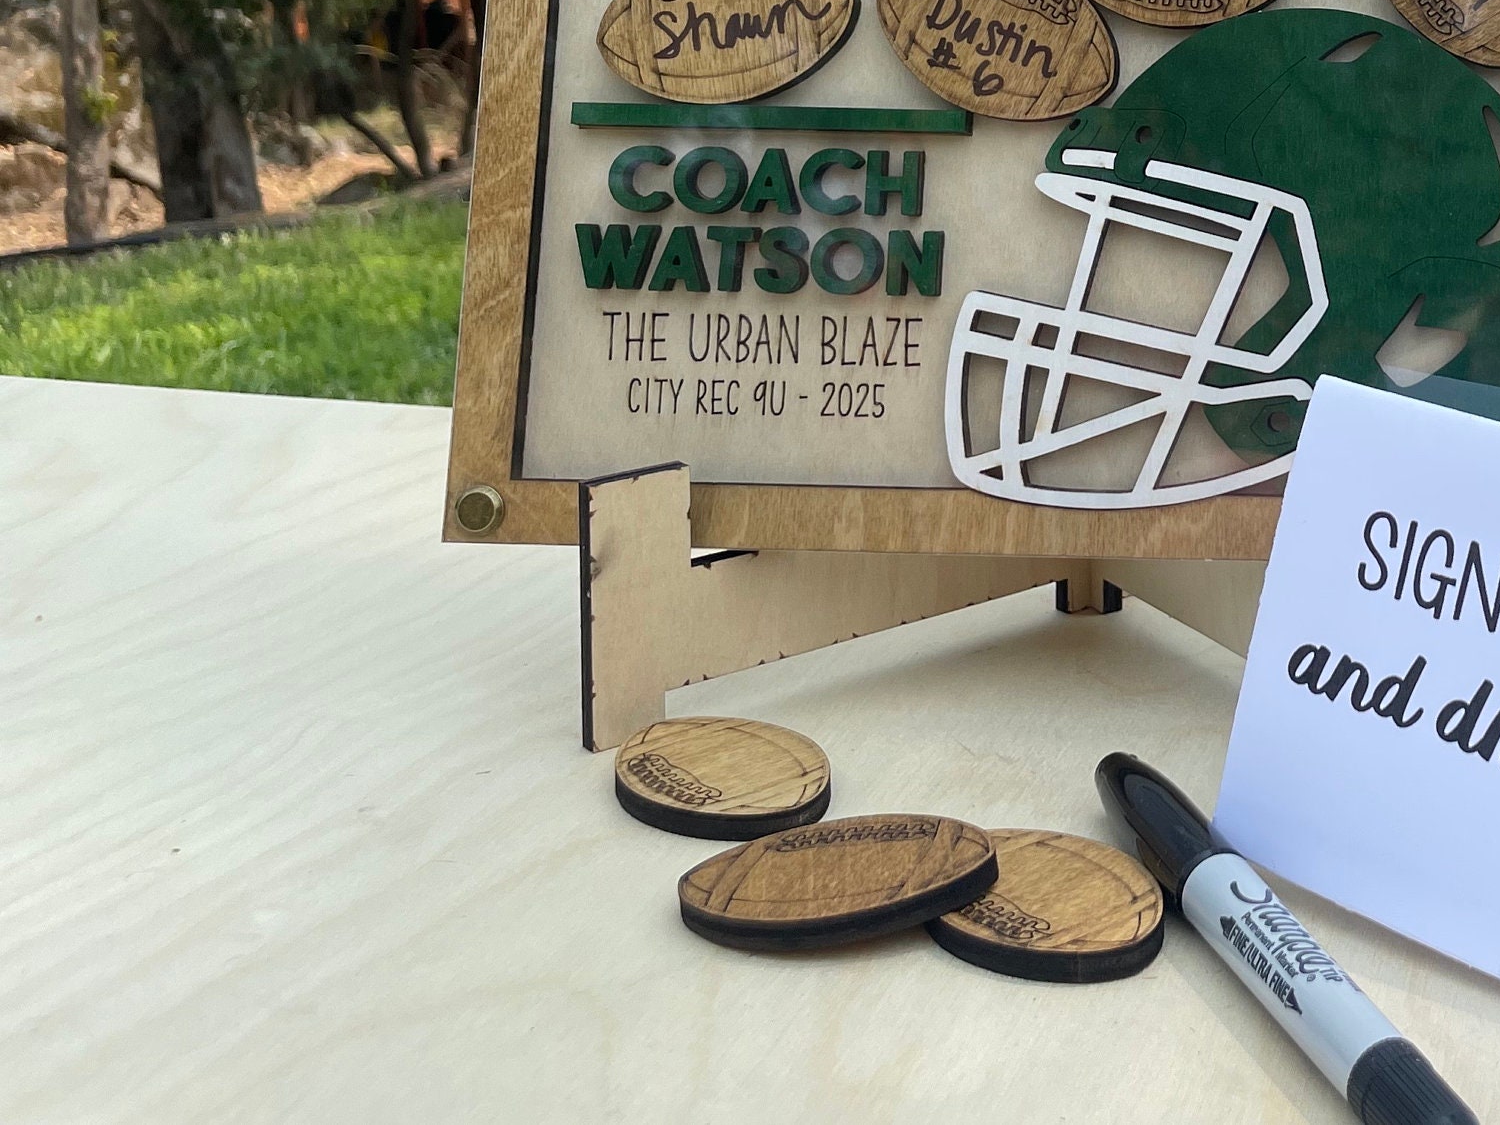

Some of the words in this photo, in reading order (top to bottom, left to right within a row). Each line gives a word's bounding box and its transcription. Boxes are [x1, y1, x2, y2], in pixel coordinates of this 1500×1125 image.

[607, 144, 926, 217] COACH
[574, 223, 945, 297] WATSON
[602, 310, 670, 363] THE
[688, 312, 800, 365] URBAN
[821, 315, 923, 368] BLAZE
[627, 376, 685, 415] CITY
[695, 378, 741, 415] REC
[753, 379, 787, 417] 9U
[820, 381, 886, 419] 2025
[1286, 641, 1427, 730] and
[1228, 924, 1273, 981] FINE/ULTRA
[1267, 972, 1292, 1003] FINE
[1241, 911, 1275, 951] Permanent
[1274, 950, 1300, 977] Marker
